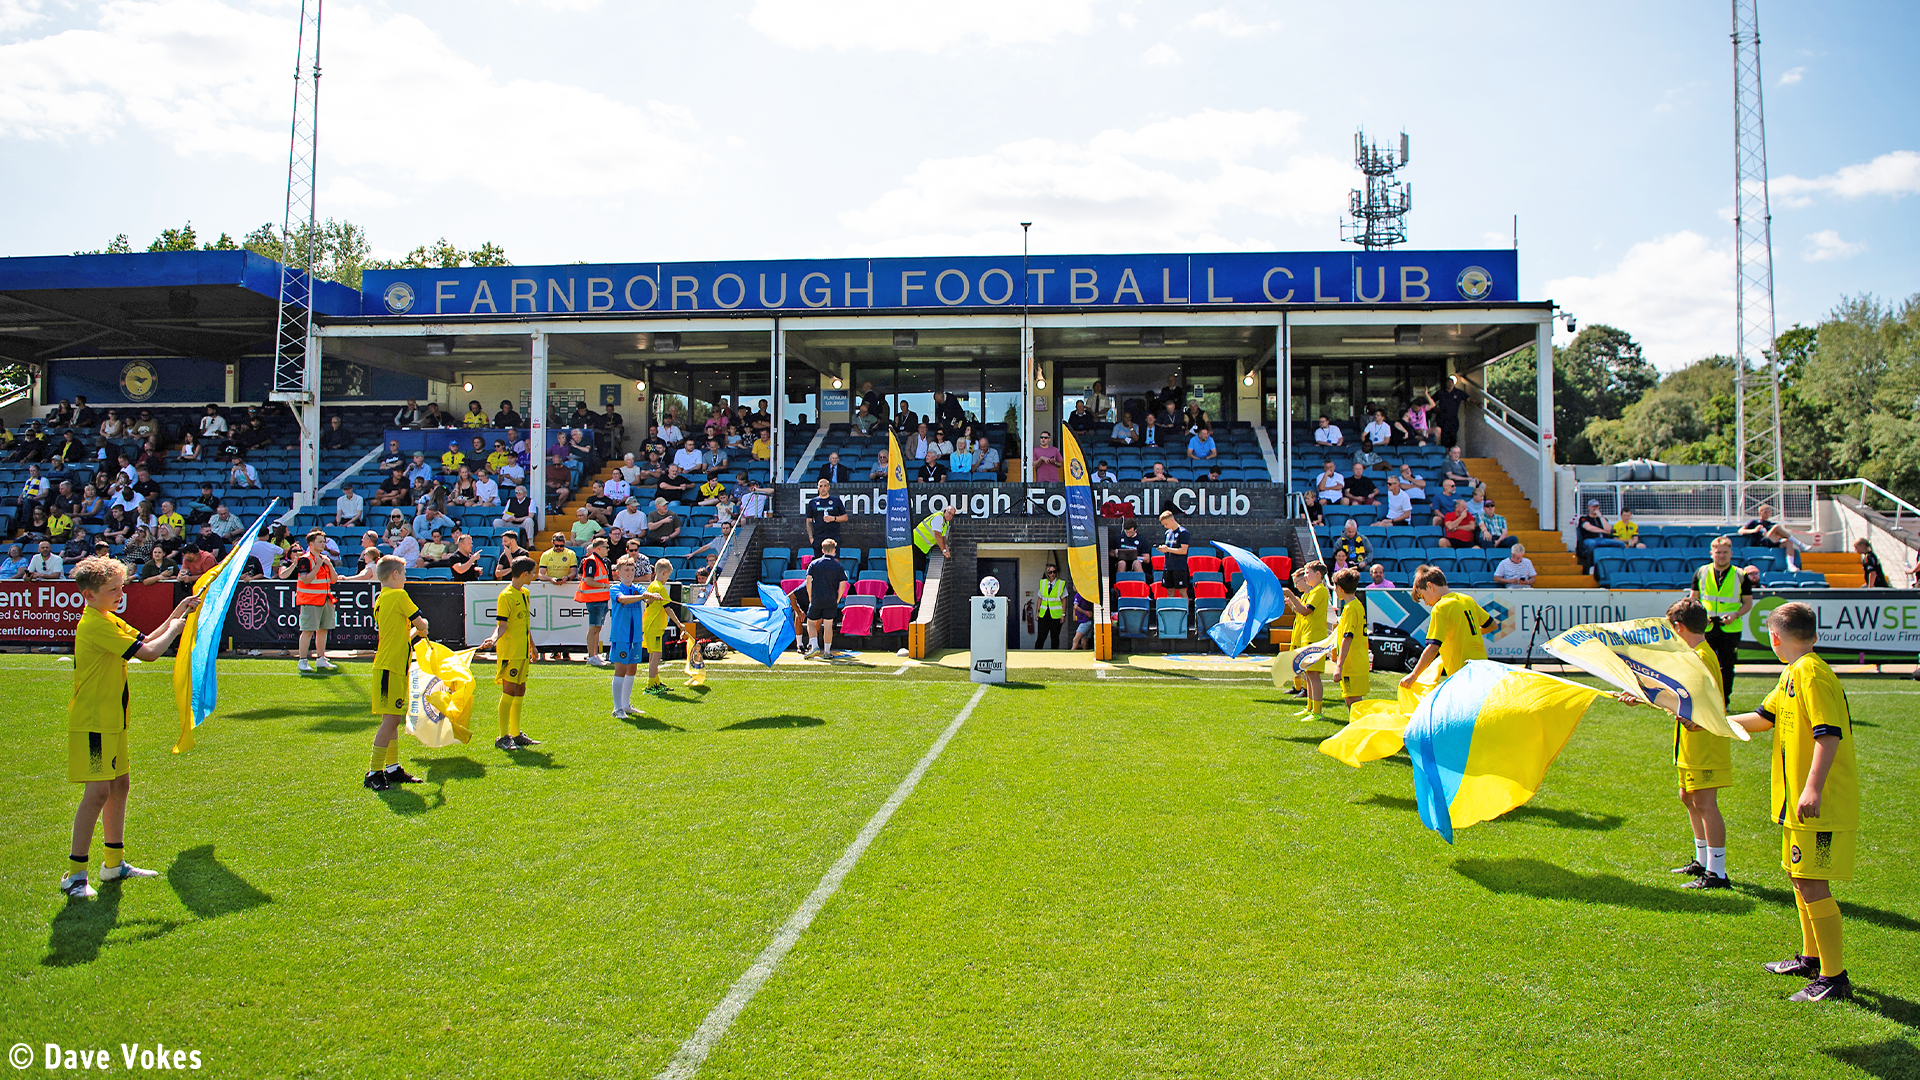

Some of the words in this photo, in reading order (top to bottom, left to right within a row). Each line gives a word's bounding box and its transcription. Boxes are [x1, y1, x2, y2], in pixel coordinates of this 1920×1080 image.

[435, 272, 874, 314] FARNBOROUGH
[901, 267, 1234, 306] FOOTBALL
[1262, 265, 1432, 303] CLUB
[800, 487, 1011, 519] Frnbrough
[1026, 487, 1160, 516] Fotball
[1173, 487, 1250, 516] Club
[13, 610, 21, 620] &
[22, 610, 61, 623] Flooring
[1521, 604, 1626, 631] EVOLUTION
[1561, 629, 1594, 647] Welc
[1621, 625, 1660, 646] home
[1818, 631, 1842, 642] Your
[1844, 631, 1872, 642] Local
[1874, 631, 1897, 642] Law
[1487, 647, 1503, 656] 912
[1505, 647, 1523, 656] 340
[1624, 659, 1660, 679] OUGH
